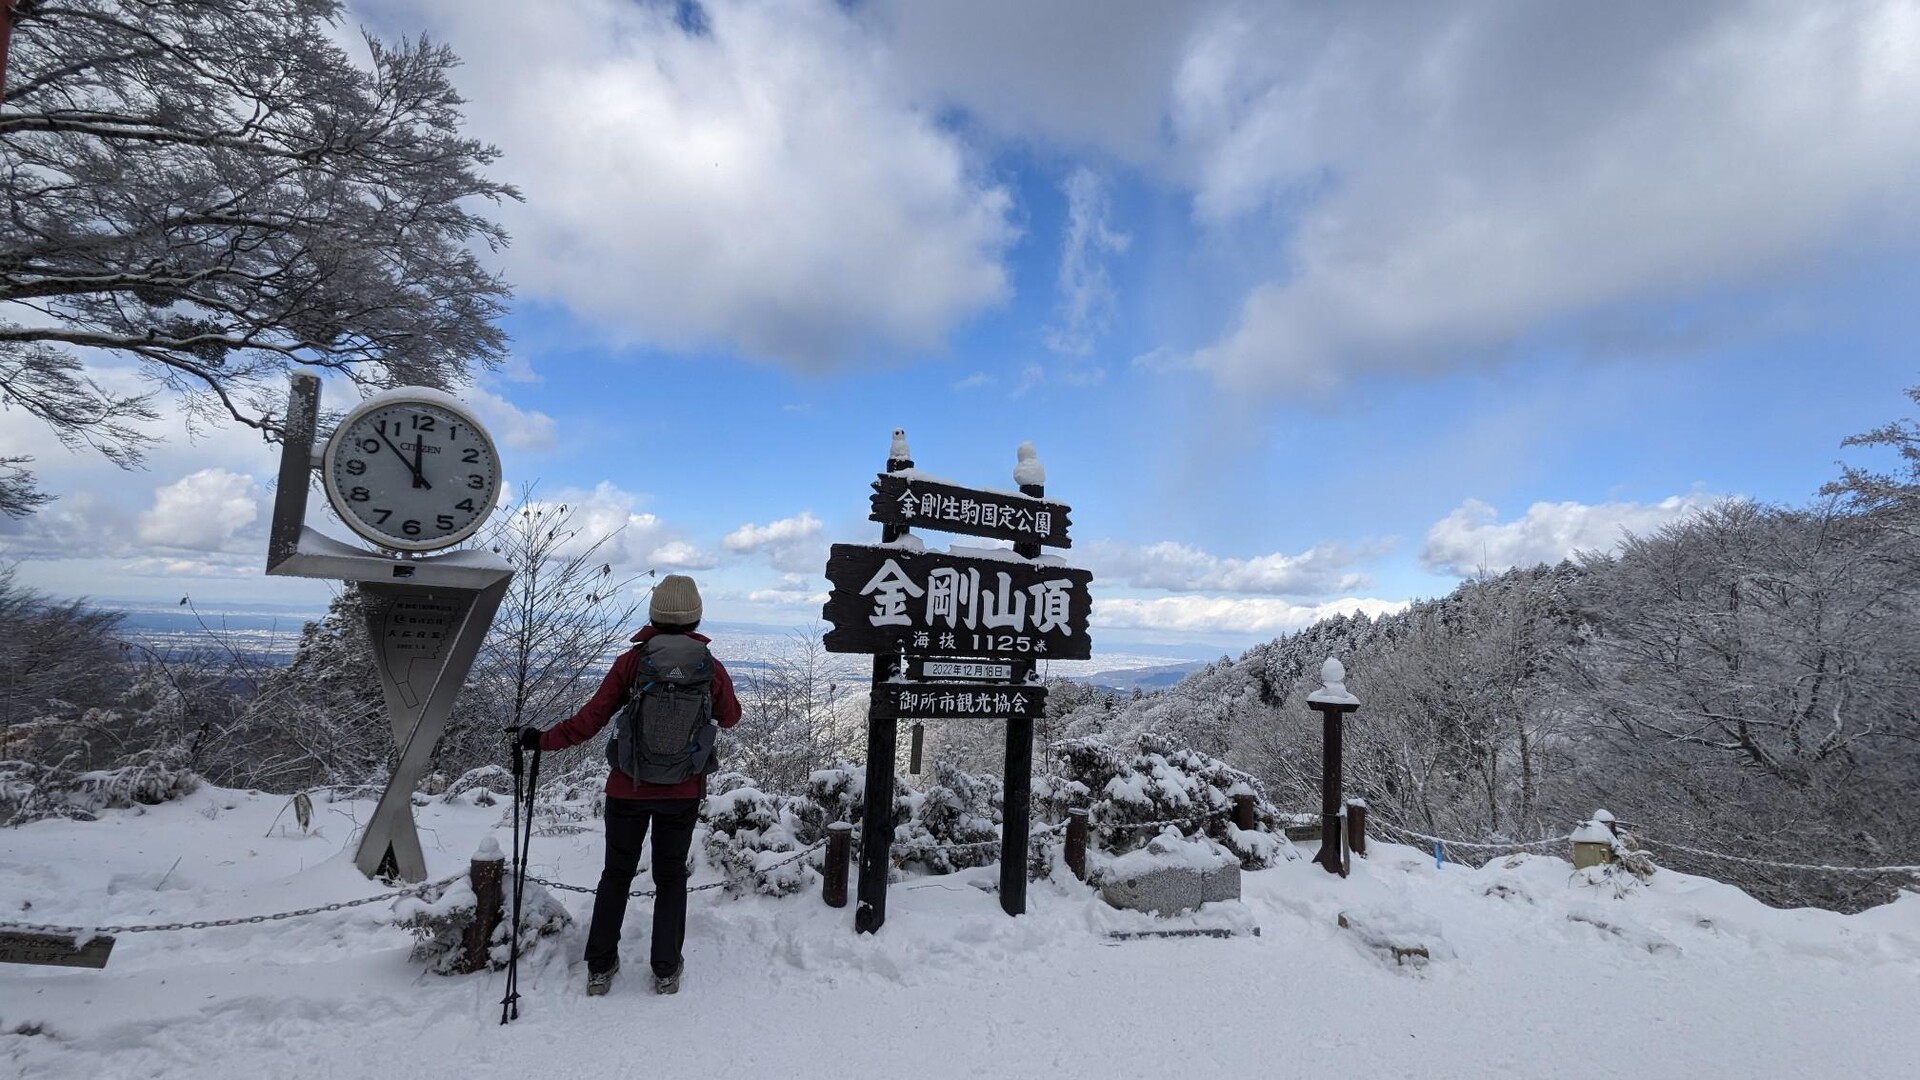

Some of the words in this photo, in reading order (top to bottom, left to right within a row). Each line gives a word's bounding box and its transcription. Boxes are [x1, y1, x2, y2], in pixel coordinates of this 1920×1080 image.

[380, 420, 401, 437] 11
[412, 415, 435, 432] 12
[450, 426, 457, 440] 1
[400, 442, 442, 455] CITZEN
[462, 448, 480, 464] 2
[346, 459, 366, 476] 9
[468, 474, 485, 490] 3
[350, 487, 370, 502] 8
[455, 498, 475, 513] 4
[897, 489, 1052, 537] 金剛生駒国定公園
[373, 508, 393, 524] 7
[436, 515, 454, 531] 5
[402, 520, 422, 535] 6
[858, 558, 1074, 637] 金剛山頂
[899, 692, 1029, 714] 御所市観光協会
